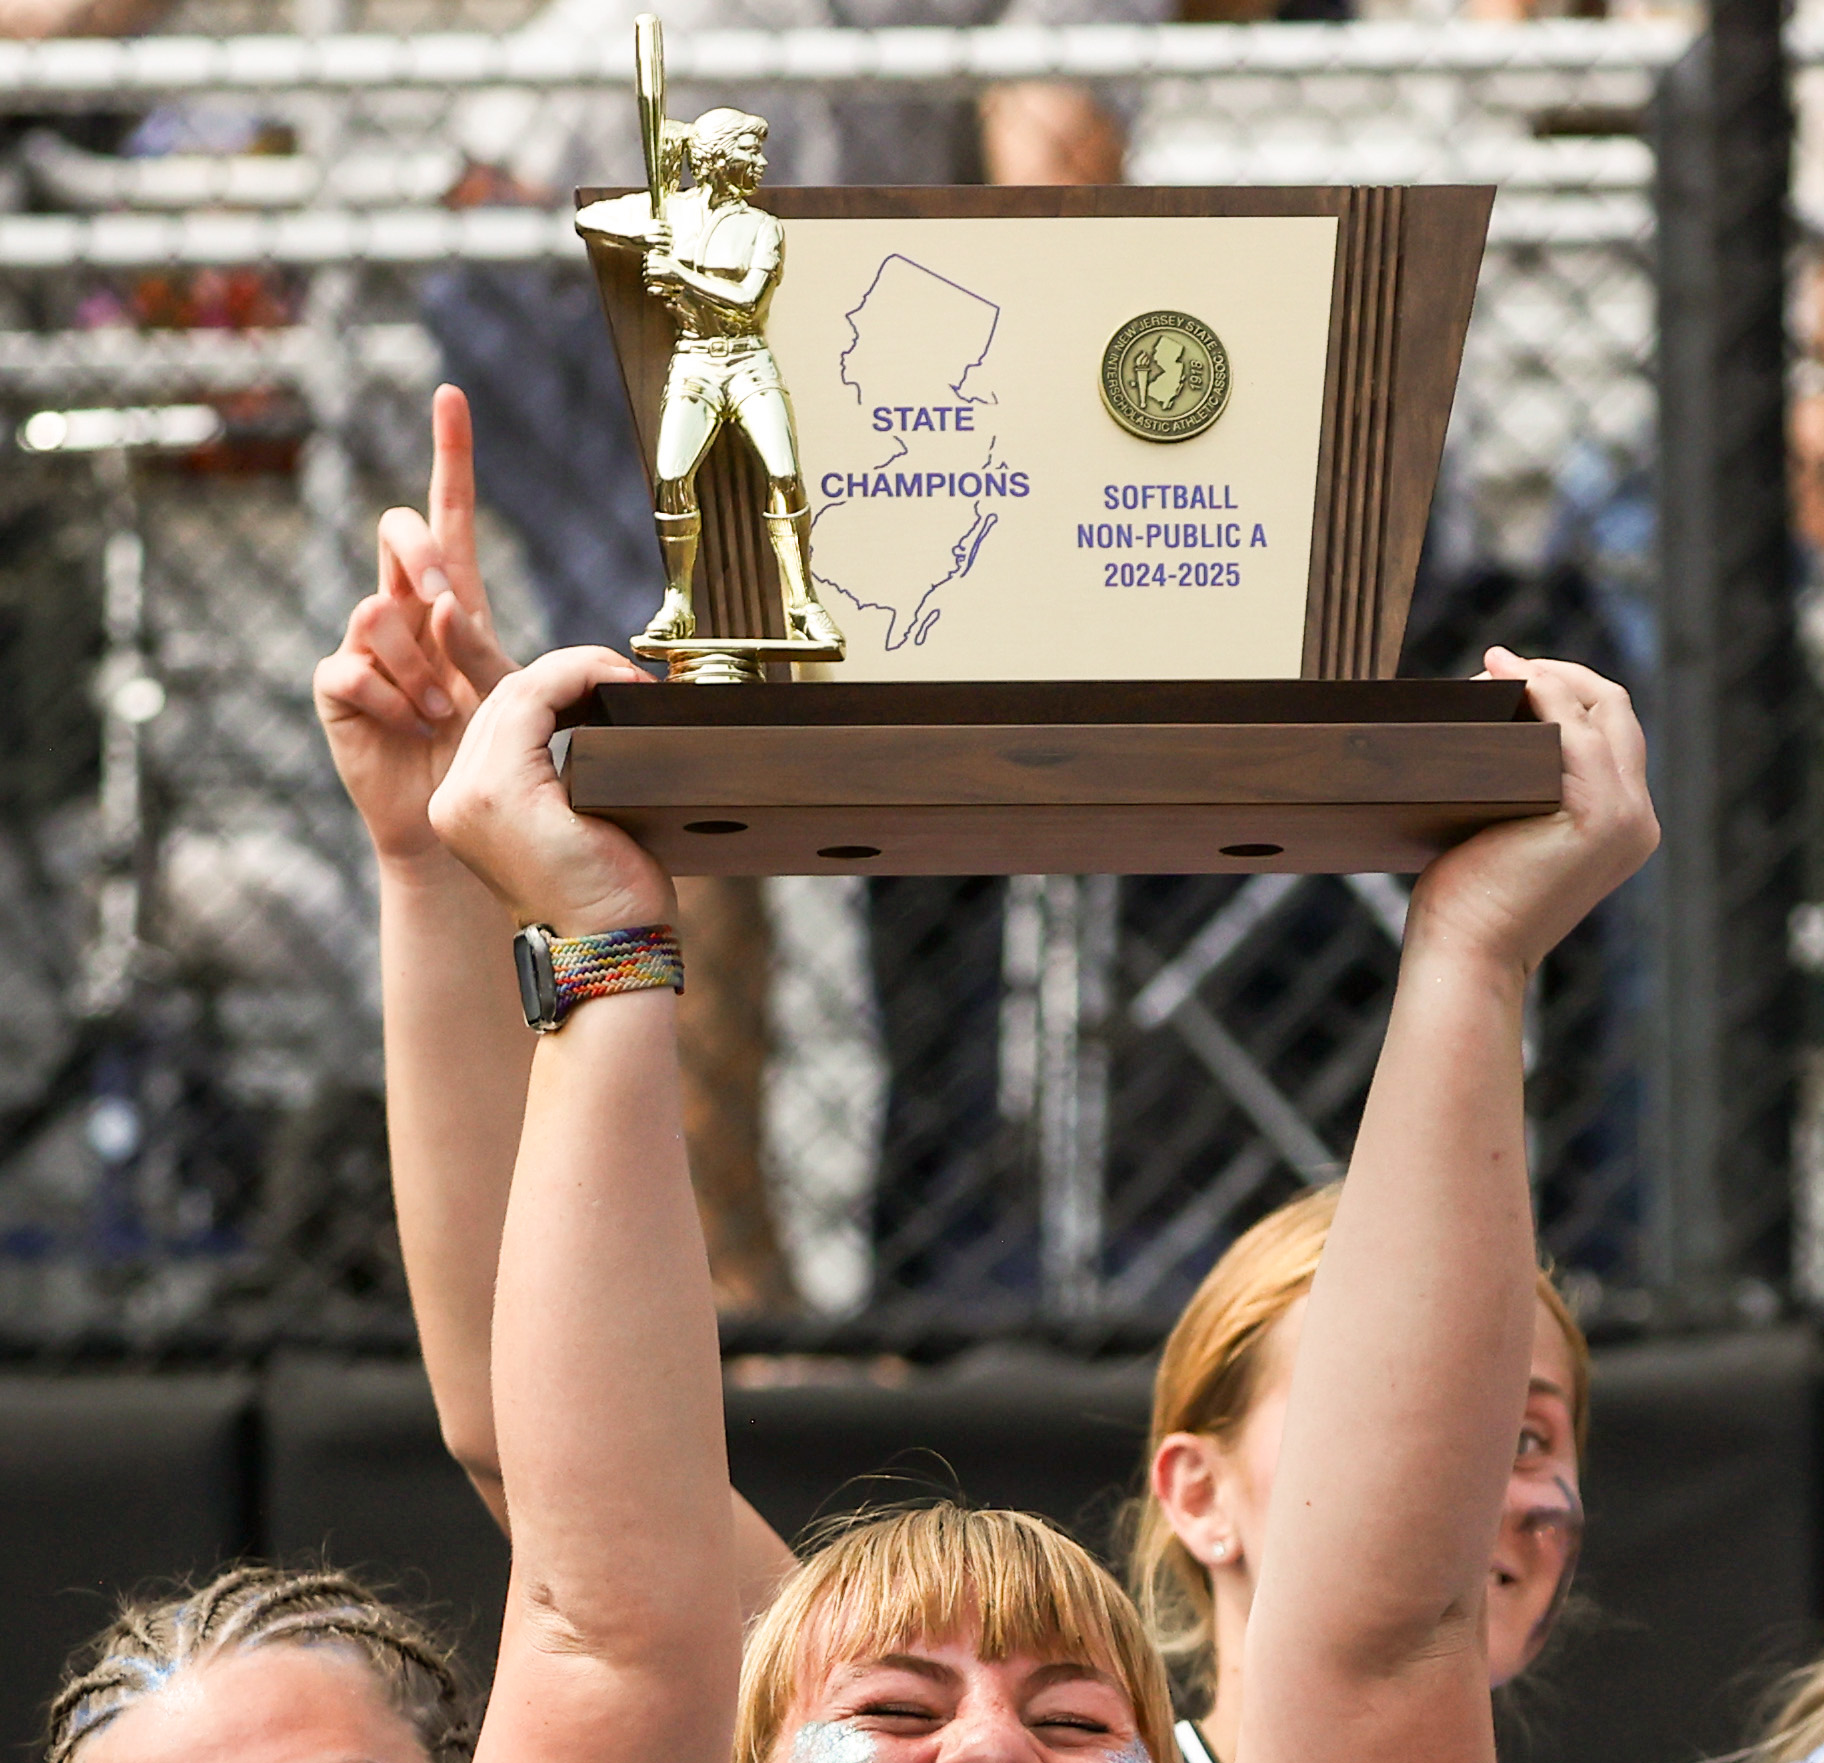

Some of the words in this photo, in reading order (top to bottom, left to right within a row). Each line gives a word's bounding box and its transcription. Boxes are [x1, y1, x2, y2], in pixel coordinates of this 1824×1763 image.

[1114, 327, 1138, 351] NEW
[1139, 315, 1184, 331] JERSEY
[1185, 321, 1218, 350] STATE
[1190, 360, 1204, 390] 1918
[1107, 353, 1170, 432] INTERSCHOLASTIC
[1172, 398, 1219, 432] ATHLETIC
[872, 406, 975, 432] STATE
[821, 472, 1030, 498] CHAMPIONS
[1104, 484, 1239, 510] SOFTBALL
[1077, 523, 1241, 548] NON-PUBLIC
[1249, 523, 1268, 548] A
[1104, 562, 1241, 587] 2024-2025
